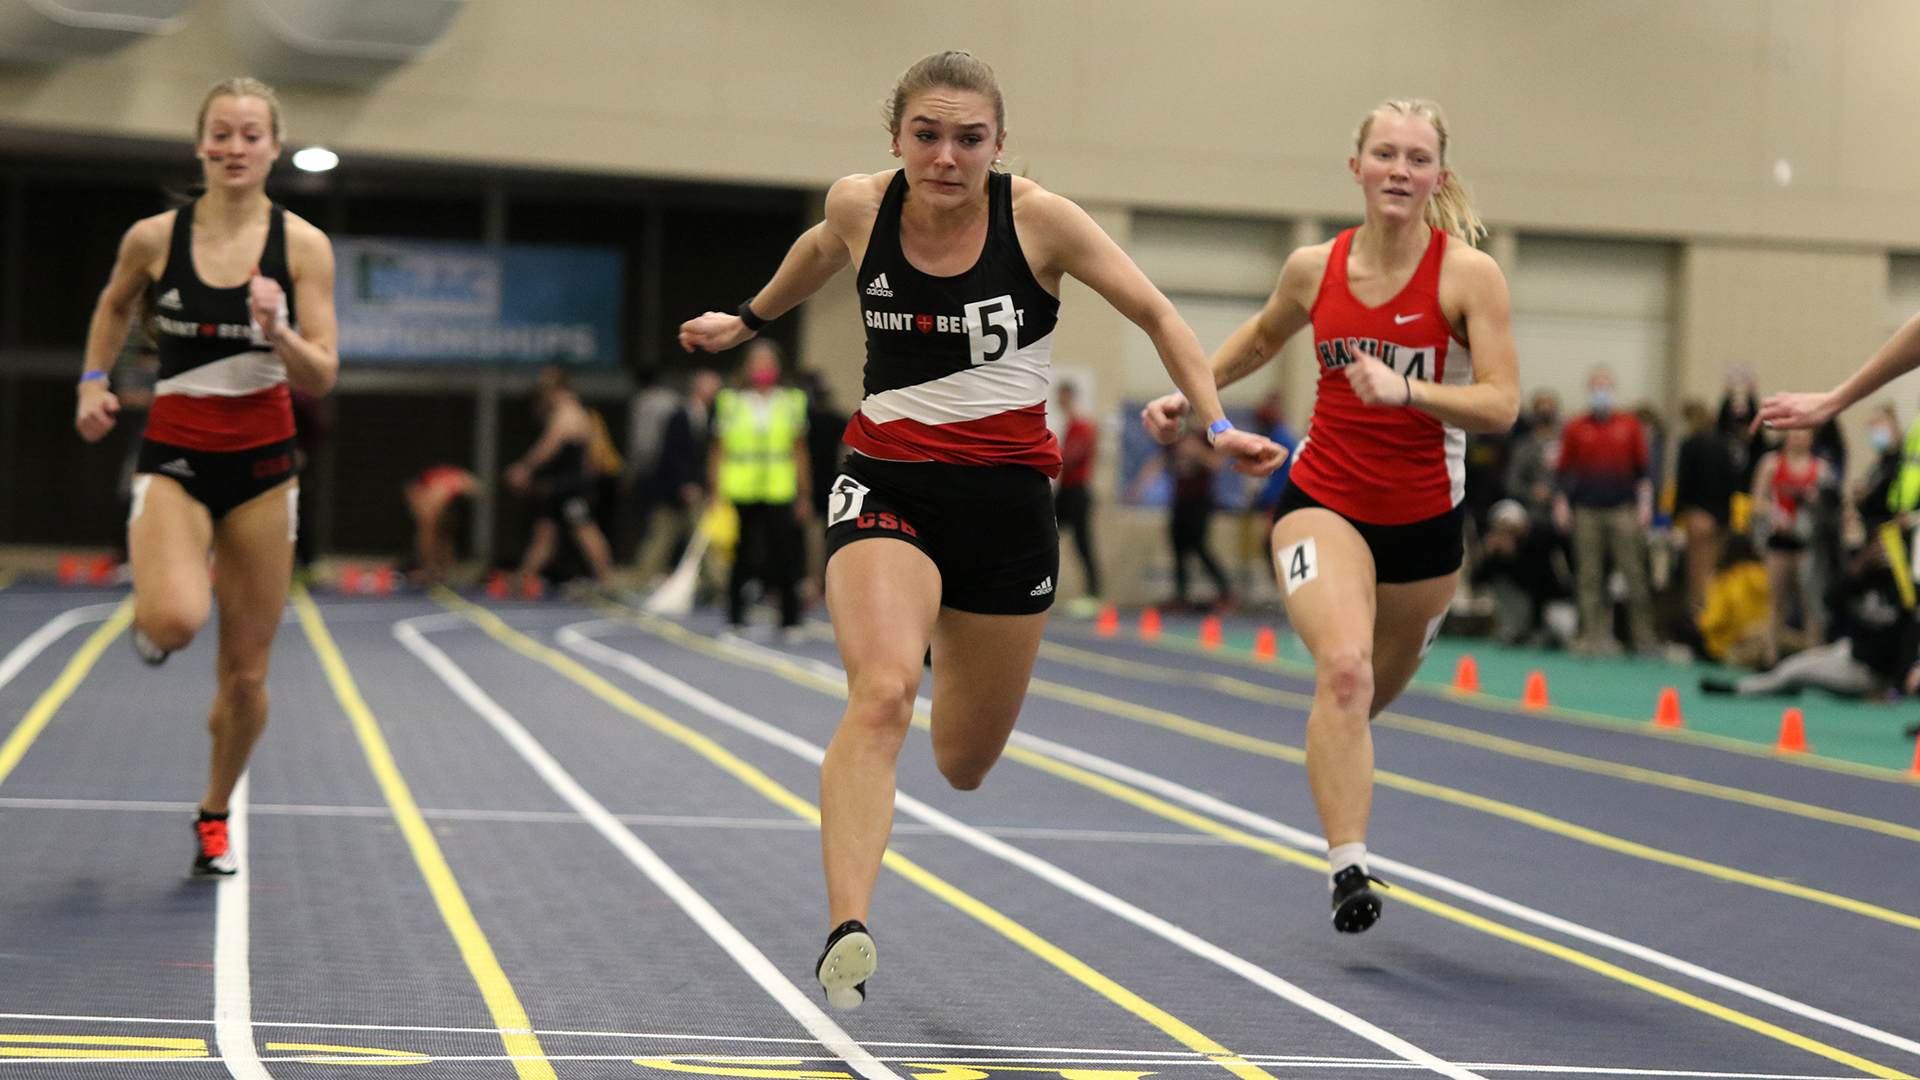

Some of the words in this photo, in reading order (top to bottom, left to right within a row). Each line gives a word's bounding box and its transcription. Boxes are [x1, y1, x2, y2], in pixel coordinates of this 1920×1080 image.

[866, 287, 893, 298] adidas
[865, 310, 913, 331] SAINT
[978, 302, 1008, 362] 5
[1290, 544, 1310, 581] 4
